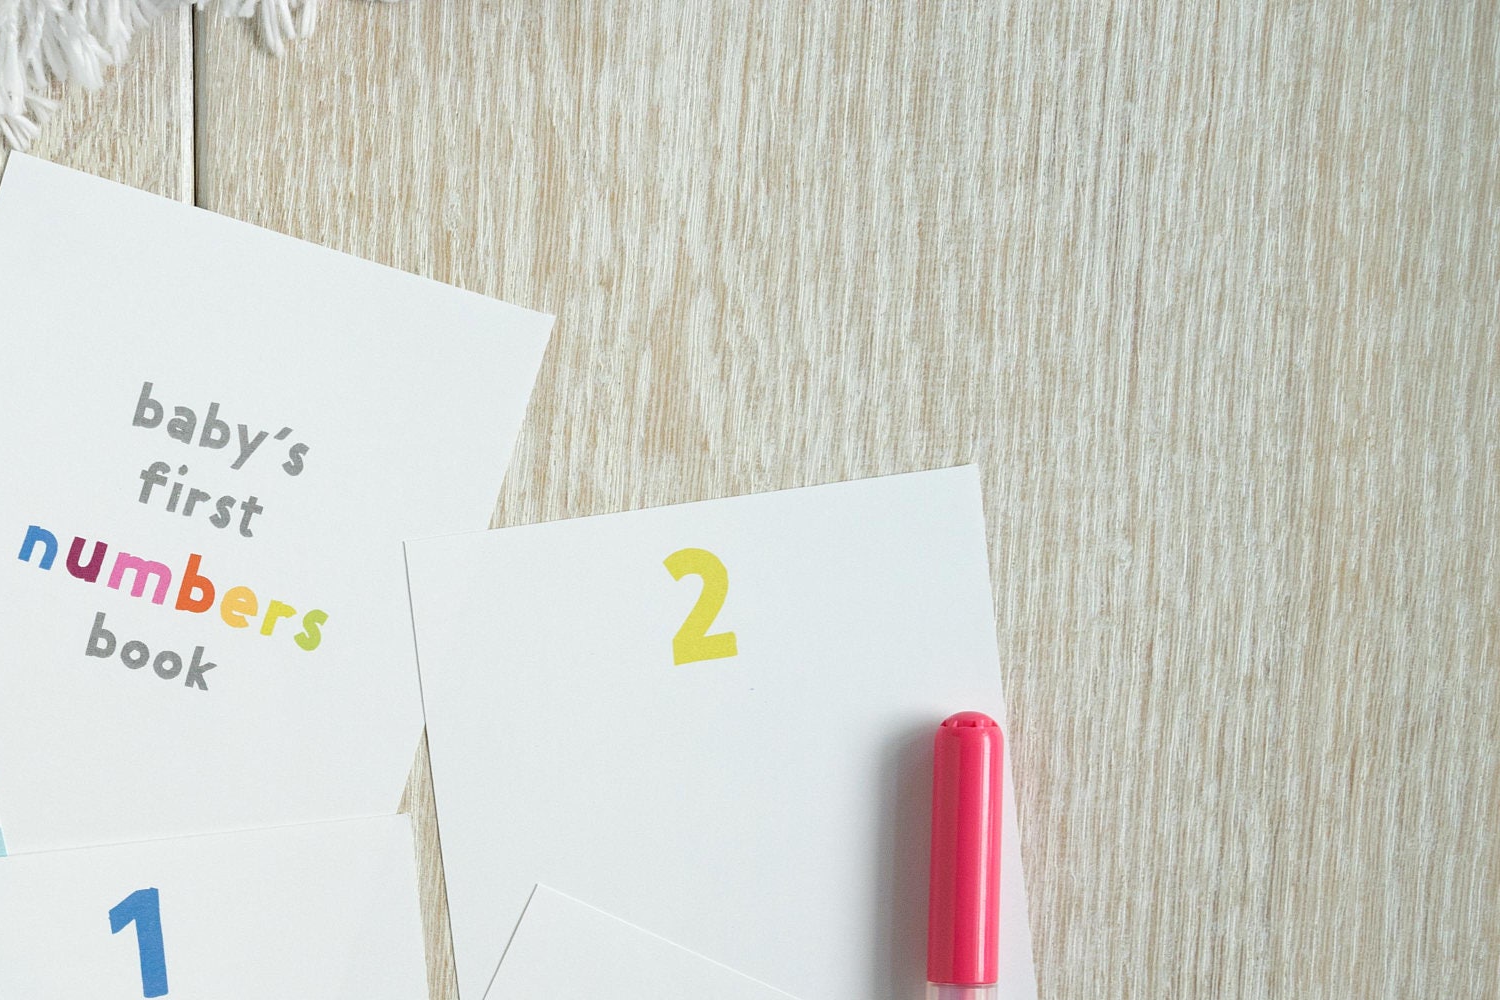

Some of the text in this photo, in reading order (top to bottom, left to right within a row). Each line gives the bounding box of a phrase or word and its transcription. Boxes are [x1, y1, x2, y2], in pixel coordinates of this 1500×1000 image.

[132, 381, 310, 477] baby's
[138, 461, 264, 538] first
[17, 524, 329, 652] numbers
[663, 547, 738, 666] 2
[85, 611, 217, 691] book
[108, 886, 169, 998] 1
